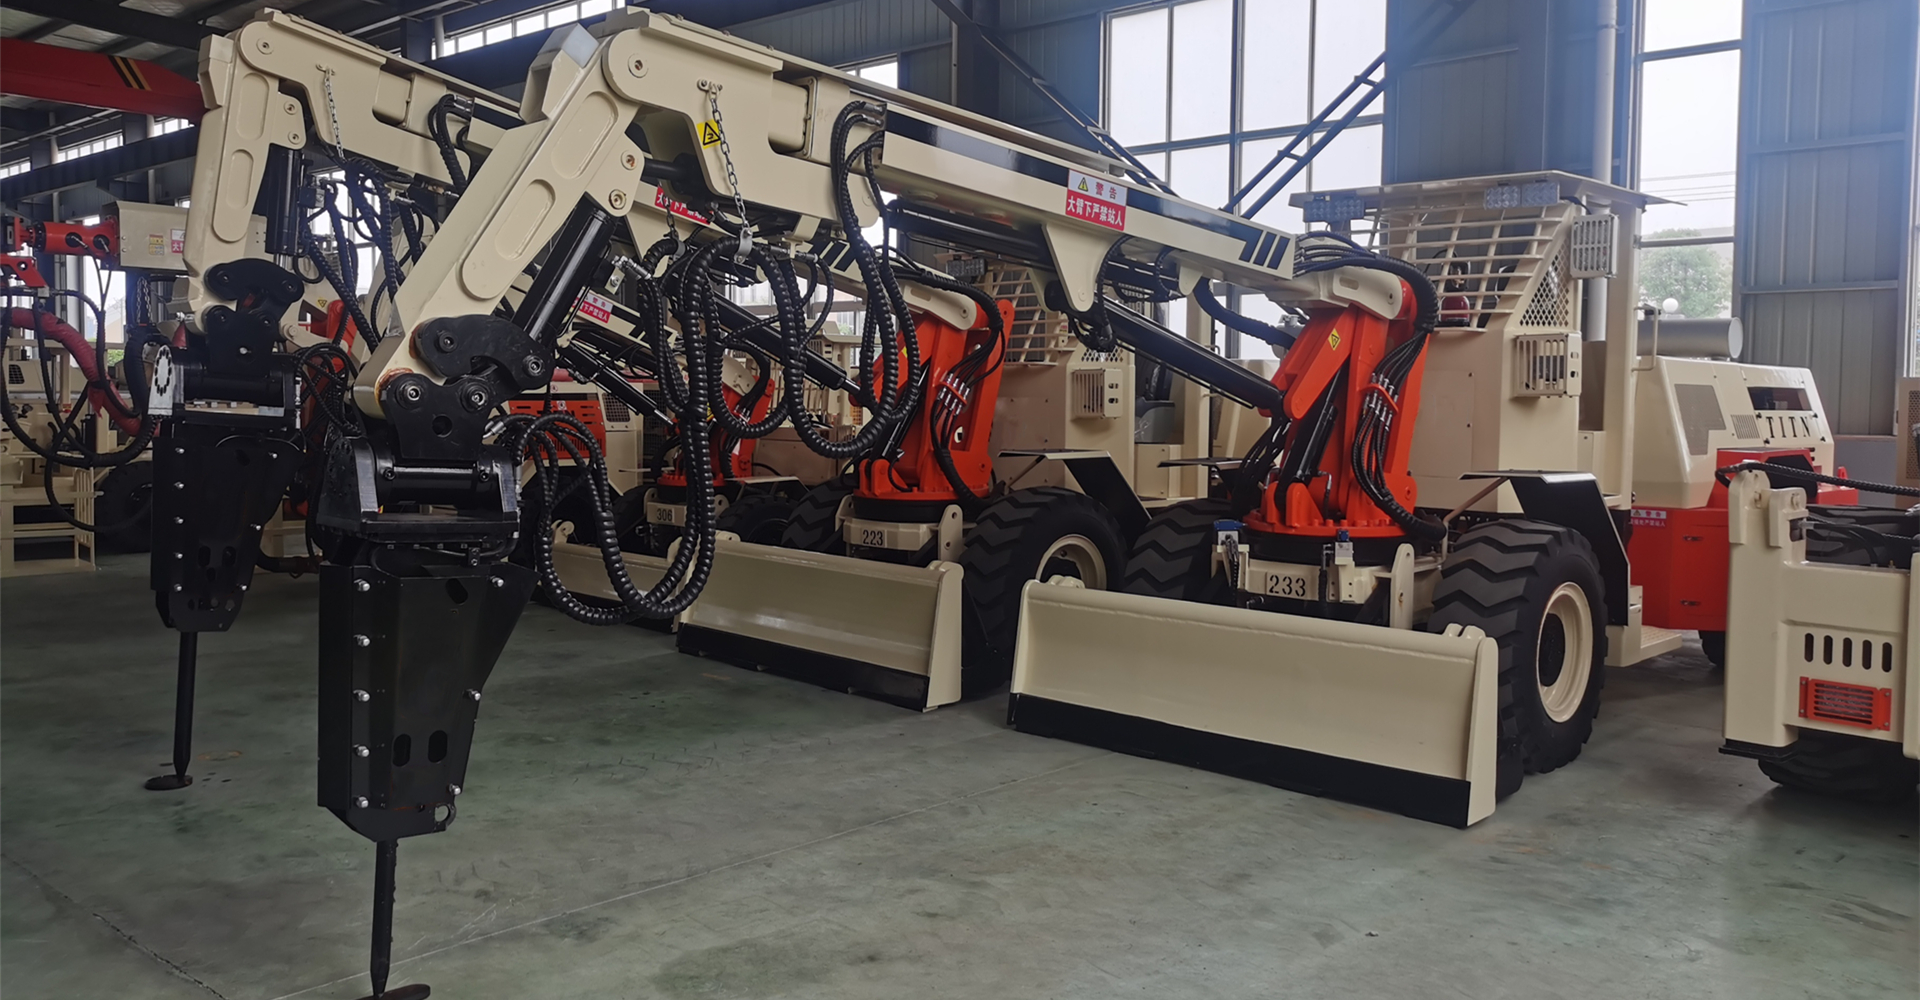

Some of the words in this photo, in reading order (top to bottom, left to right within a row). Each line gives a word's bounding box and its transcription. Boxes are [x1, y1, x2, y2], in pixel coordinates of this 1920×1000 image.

[1095, 181, 1117, 200] 警告
[1067, 195, 1122, 226] 大臂下严禁站人
[1765, 415, 1811, 438] TITN
[656, 508, 673, 521] 306
[862, 529, 883, 546] 223
[1269, 574, 1306, 597] 233
